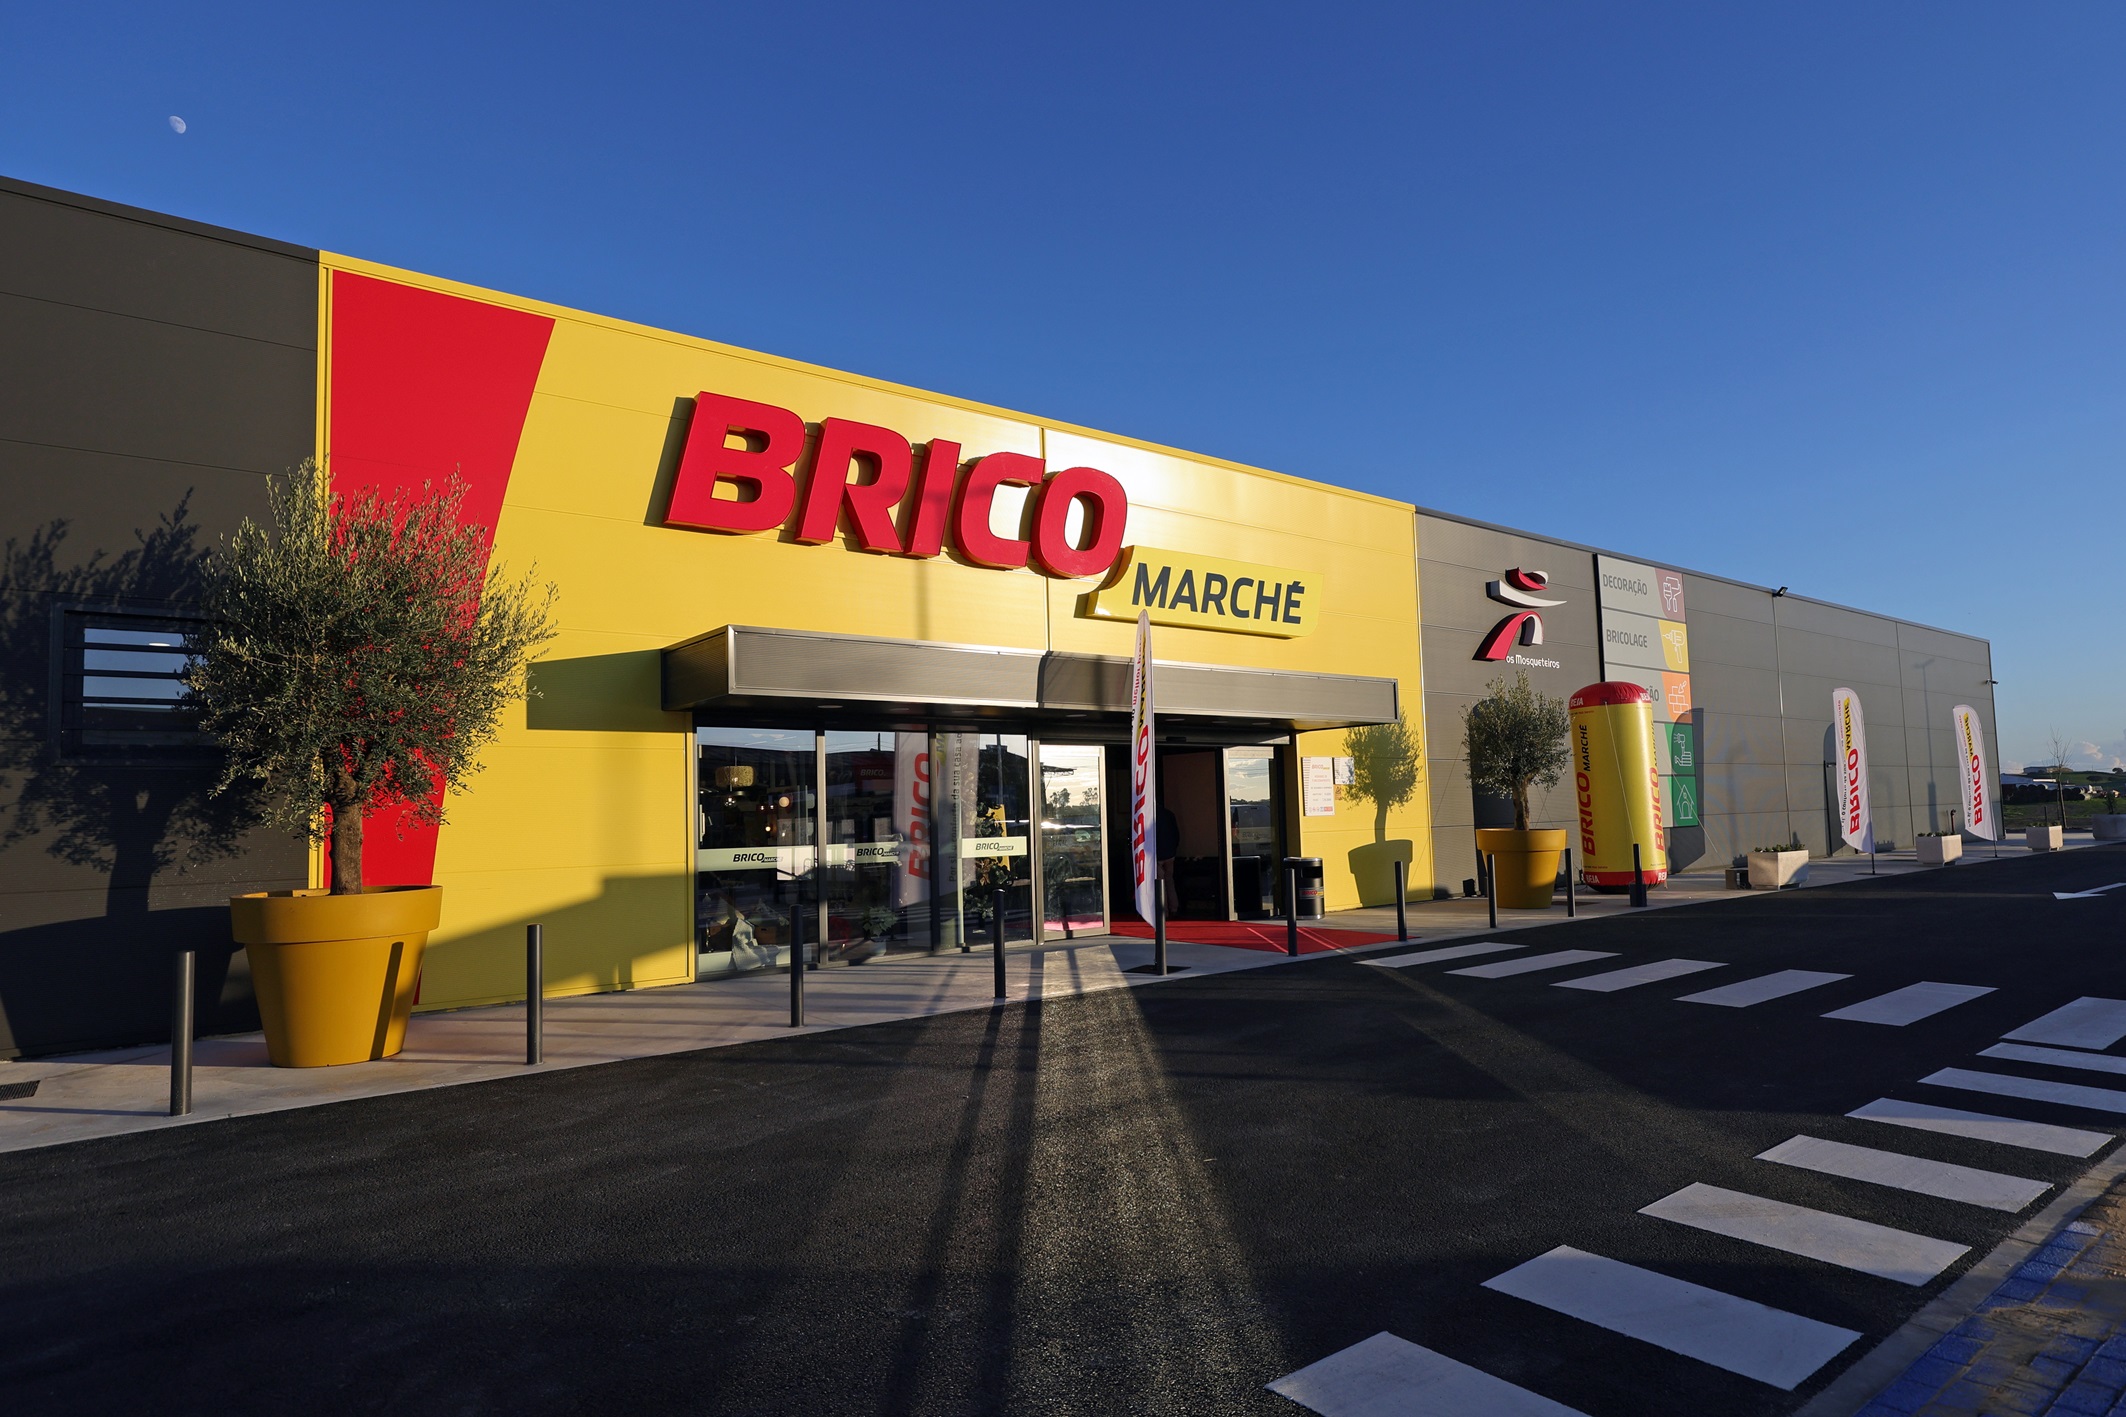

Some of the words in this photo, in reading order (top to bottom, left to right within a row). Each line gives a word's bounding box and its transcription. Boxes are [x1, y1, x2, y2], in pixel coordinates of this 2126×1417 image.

[664, 391, 1127, 578] BRICO
[1131, 562, 1306, 625] MARCHÉ
[1602, 573, 1648, 596] DECORAÇÃO
[1606, 629, 1648, 648] BRICOLAGE
[1505, 655, 1515, 664] os
[1515, 654, 1560, 669] Mosqueteiros
[954, 747, 962, 767] casa
[950, 788, 960, 800] da
[908, 752, 941, 881] BRICO
[1576, 771, 1596, 857] BRICO
[1649, 767, 1665, 852] BRICO
[856, 847, 884, 857] BRICO
[975, 842, 1000, 851] BRICO
[733, 852, 765, 863] BRICO
